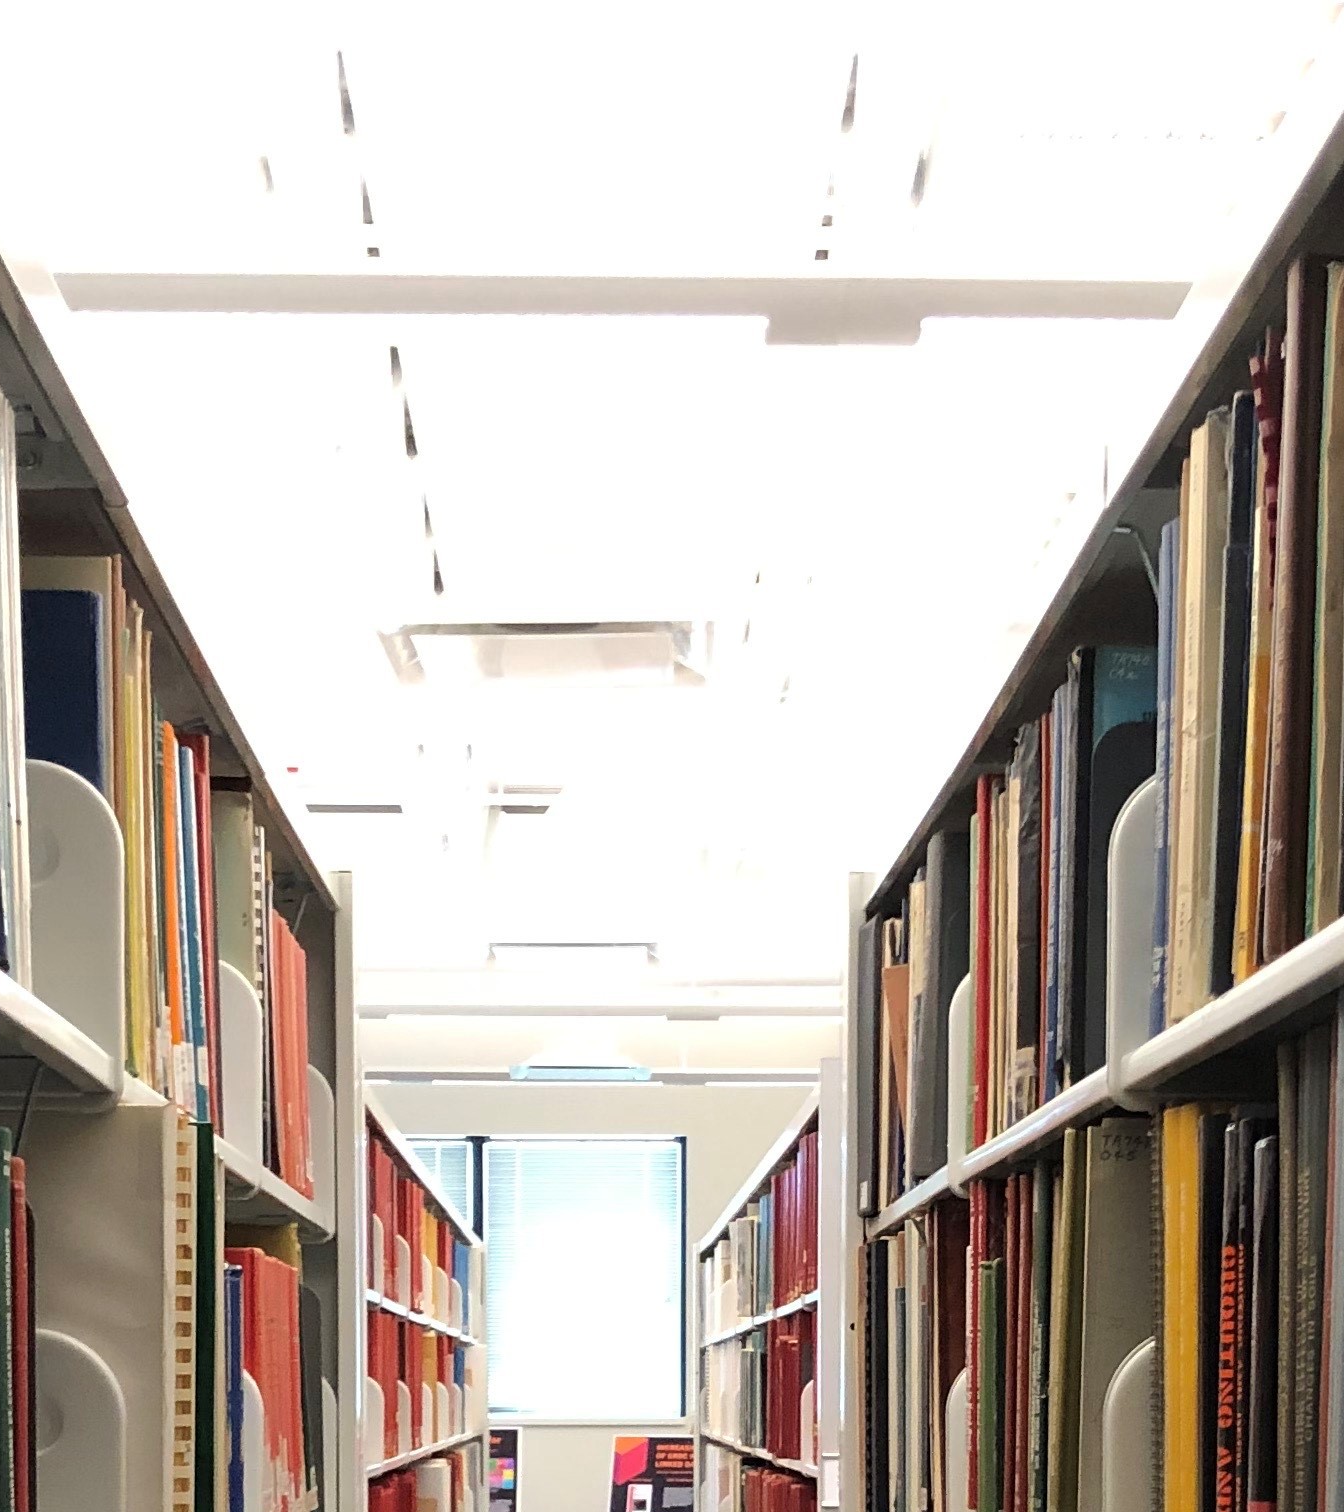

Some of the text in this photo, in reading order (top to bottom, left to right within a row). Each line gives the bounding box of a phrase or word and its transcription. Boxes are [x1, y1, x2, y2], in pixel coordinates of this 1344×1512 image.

[1218, 1244, 1237, 1429] GROUTING
[1305, 1256, 1316, 1441] CHANGES IN SOILS
